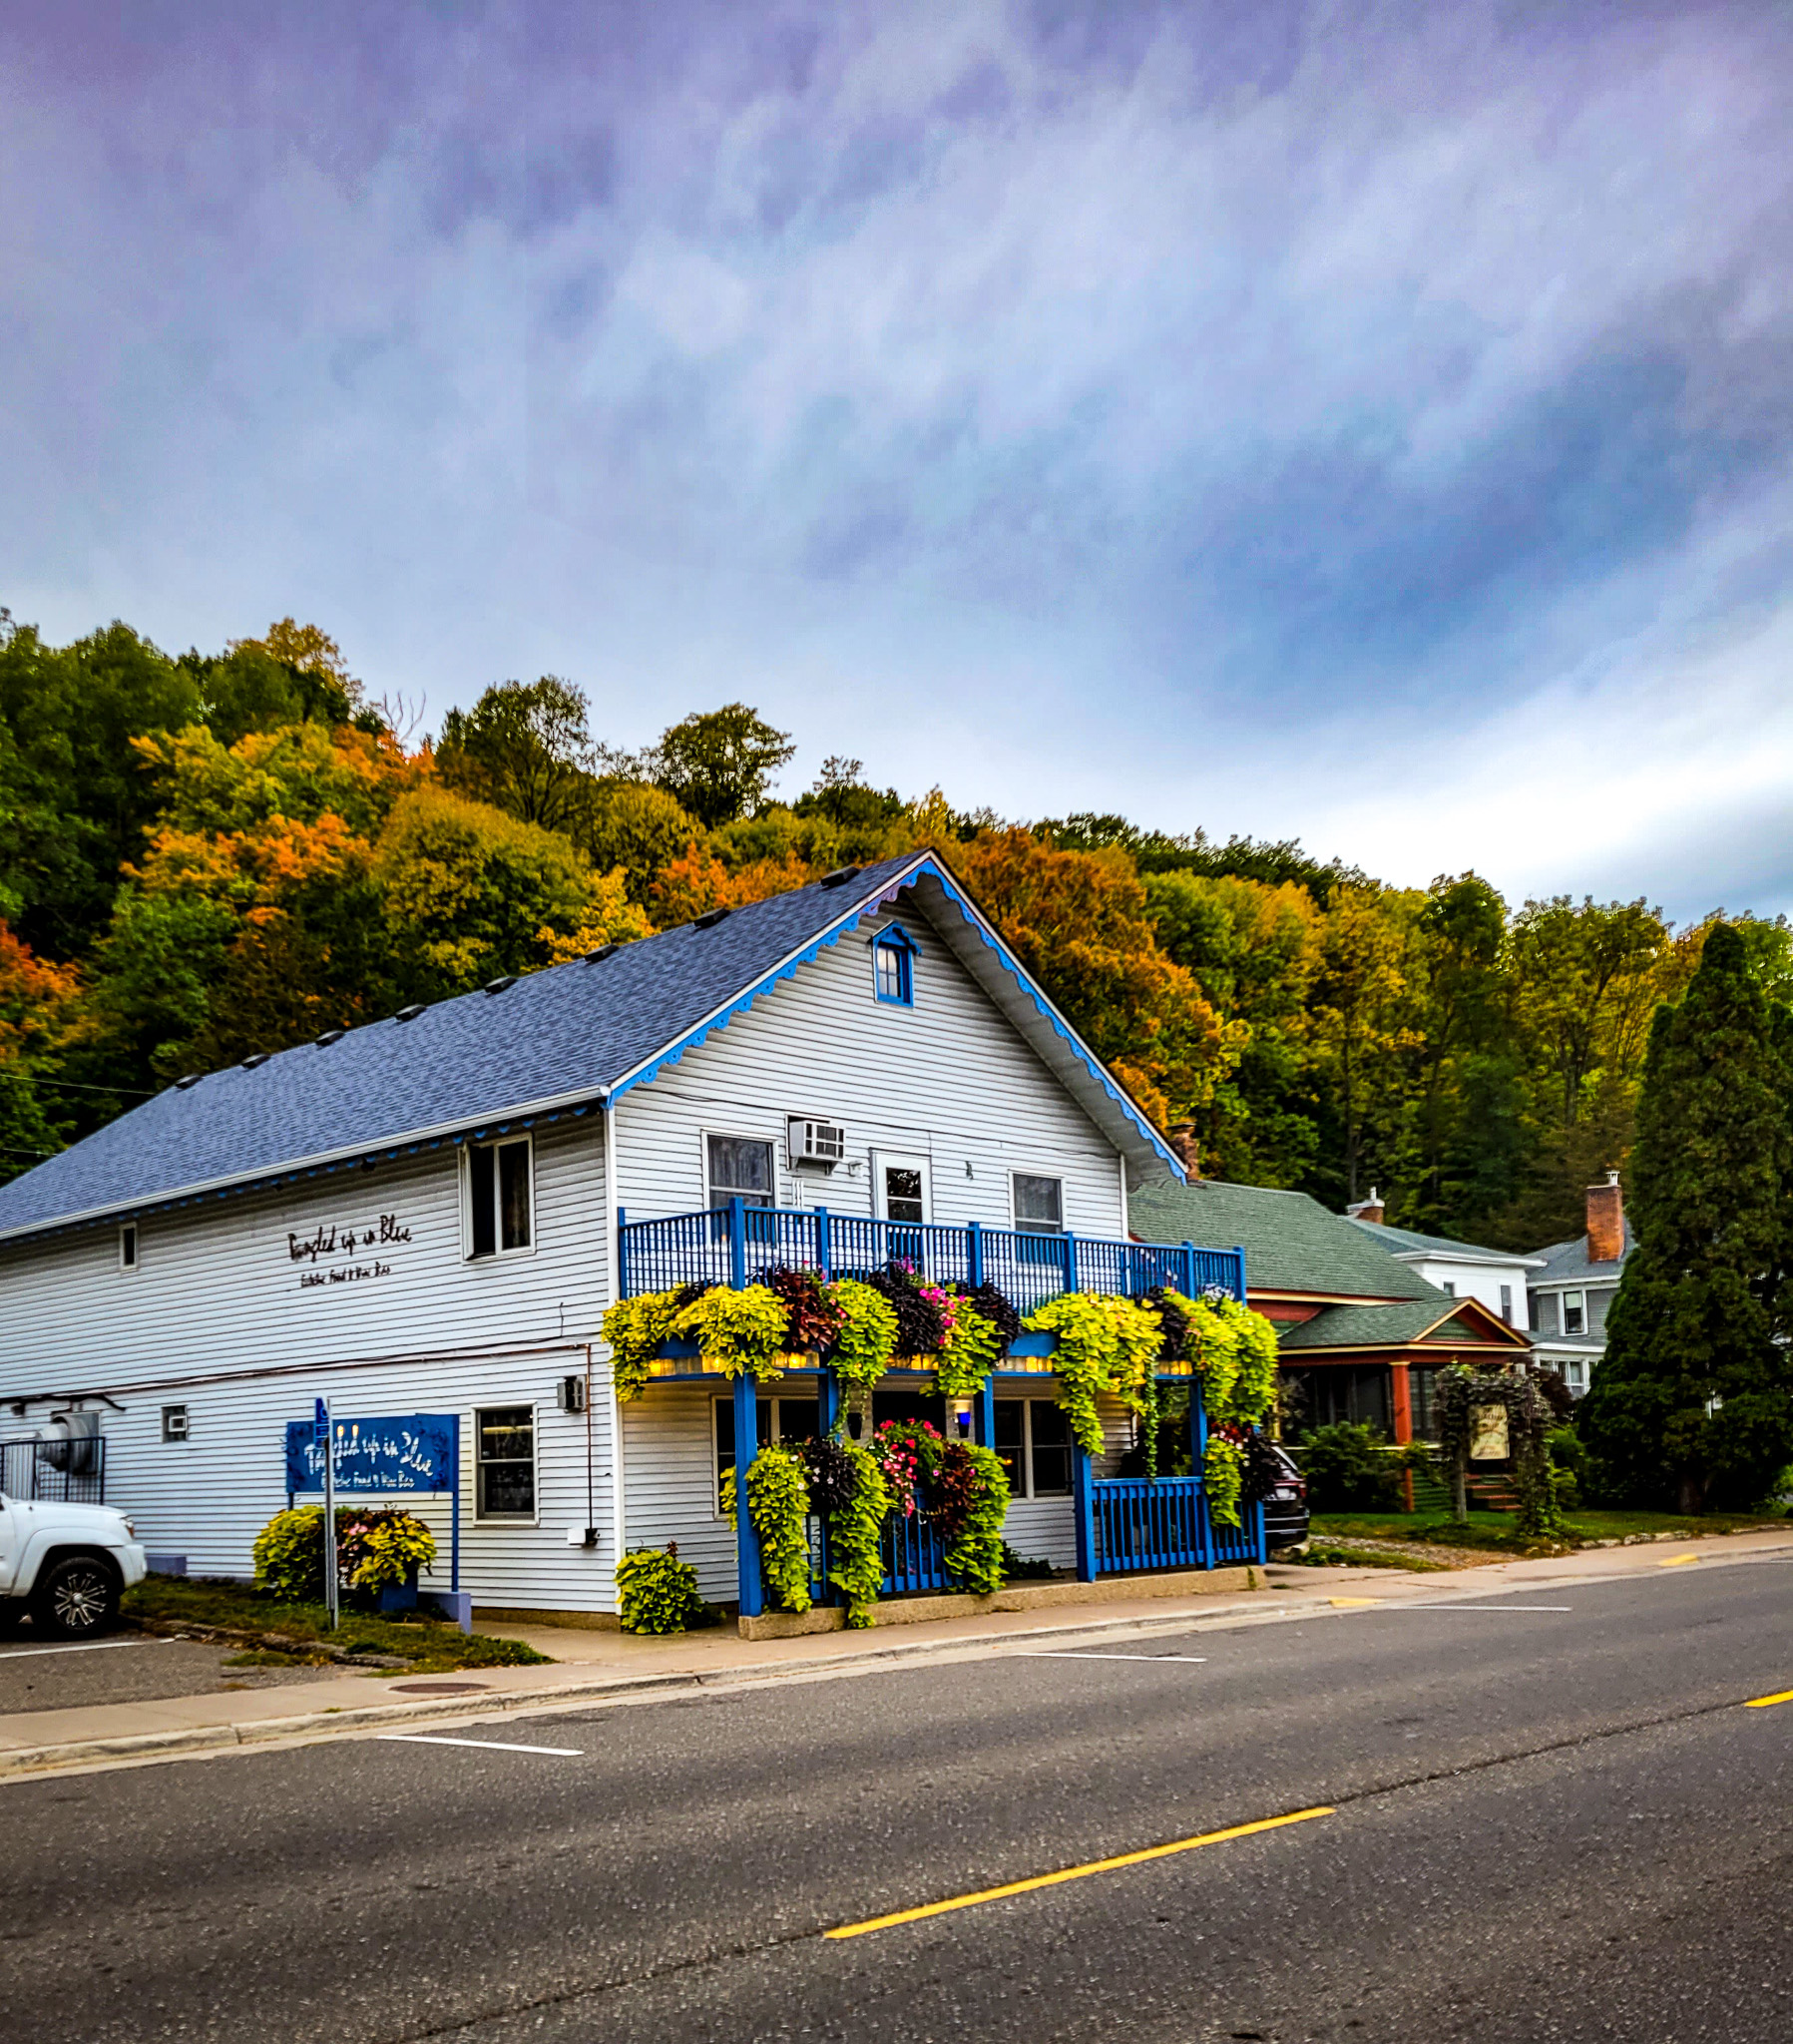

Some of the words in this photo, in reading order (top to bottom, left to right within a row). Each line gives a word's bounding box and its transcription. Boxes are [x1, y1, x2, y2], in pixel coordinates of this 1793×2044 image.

[287, 1226, 335, 1263] Tangled
[340, 1230, 356, 1257] up
[363, 1230, 375, 1245] in
[380, 1214, 412, 1244] Blue
[362, 1433, 380, 1464] up
[383, 1437, 399, 1458] in
[400, 1431, 433, 1476] Blue
